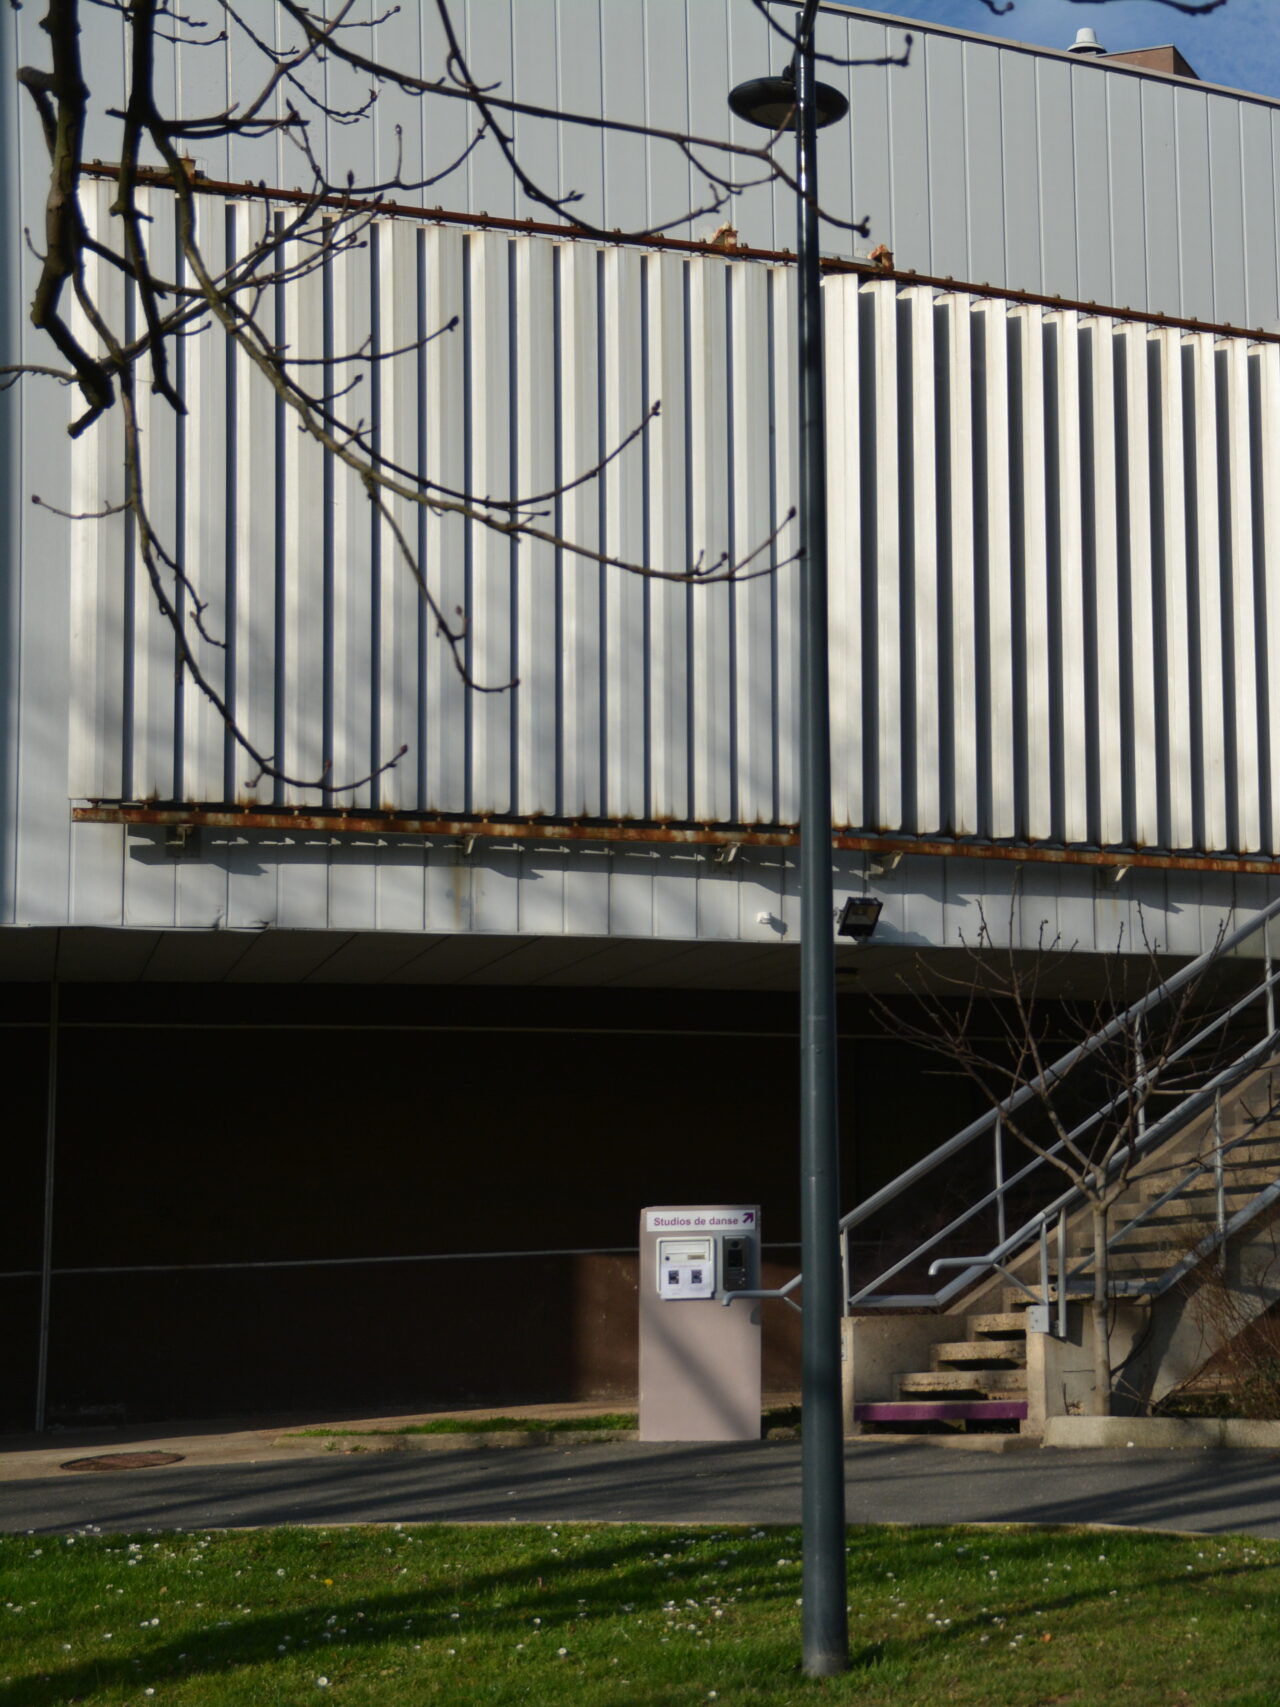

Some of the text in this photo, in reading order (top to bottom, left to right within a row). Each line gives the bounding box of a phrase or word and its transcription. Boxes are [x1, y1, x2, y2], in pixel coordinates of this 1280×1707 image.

[654, 1216, 738, 1226] Studios de danse
